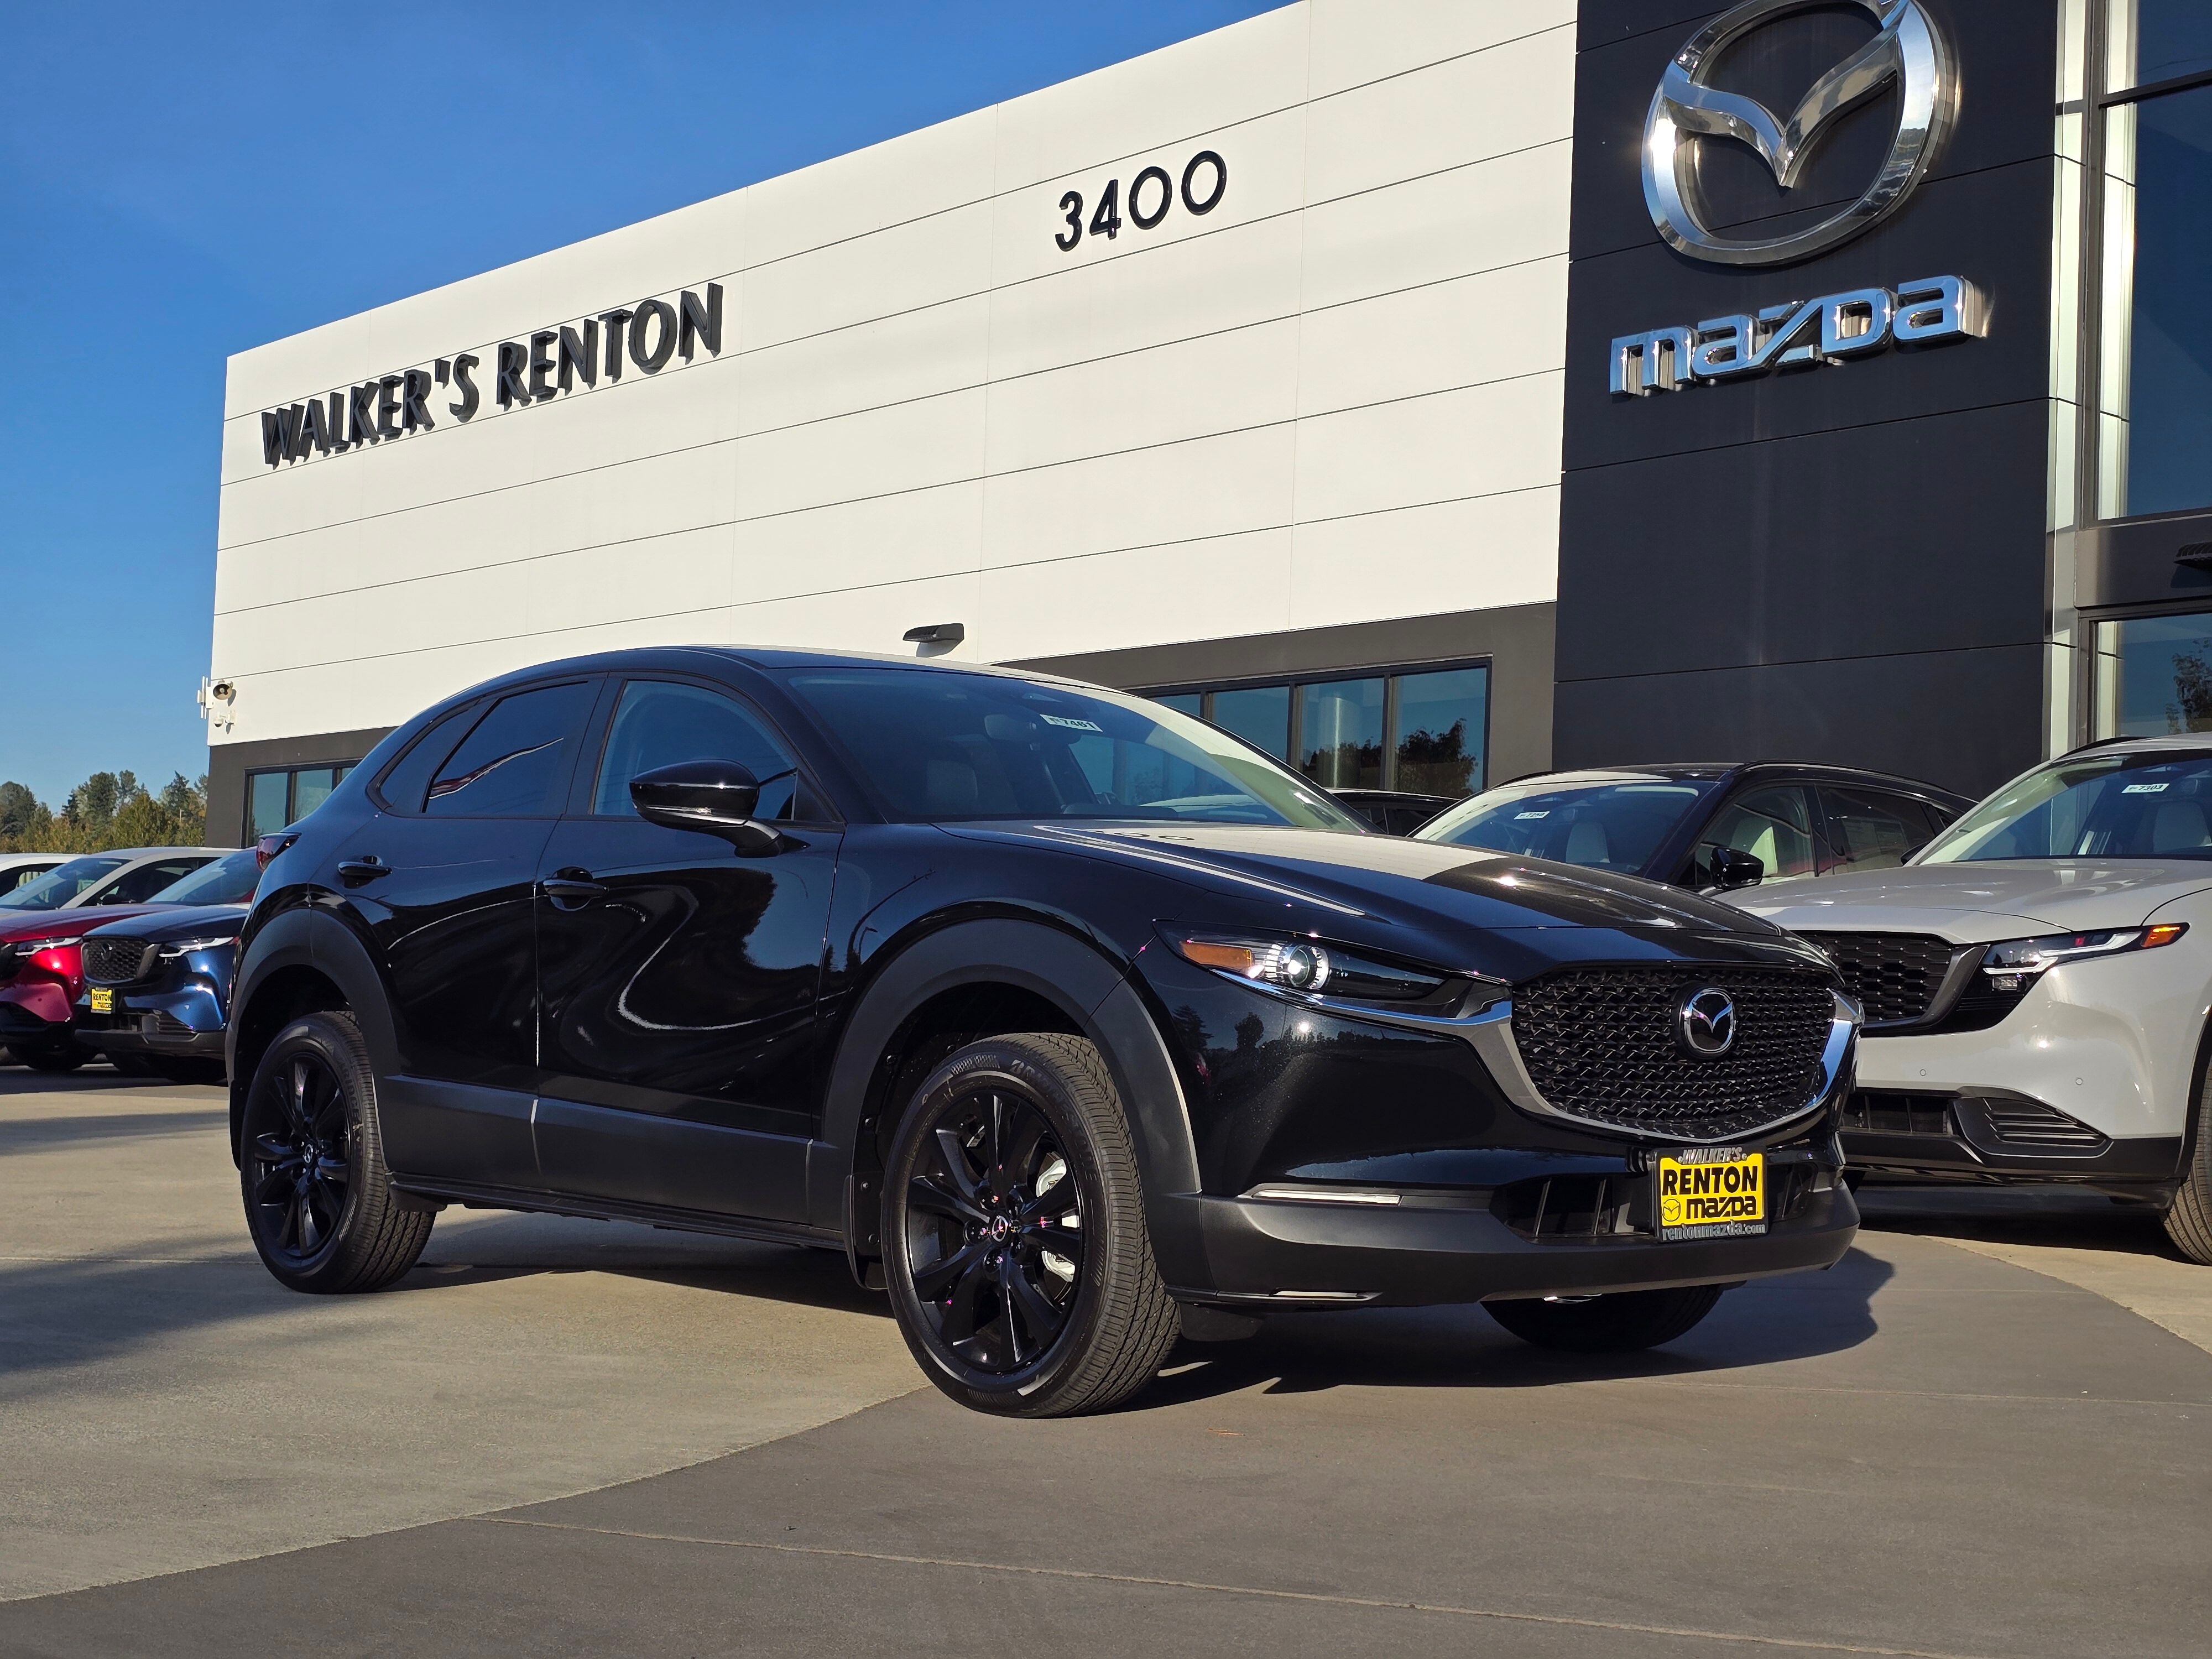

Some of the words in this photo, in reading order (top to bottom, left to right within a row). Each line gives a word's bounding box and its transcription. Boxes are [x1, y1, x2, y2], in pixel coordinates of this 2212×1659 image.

[1055, 150, 1227, 252] 3400
[1609, 275, 1986, 395] mazda
[262, 354, 479, 469] WALKER'S
[497, 283, 723, 411] RENTON
[1682, 1147, 1743, 1165] WALKER'S
[1662, 1165, 1758, 1196] RENTON
[1686, 1196, 1757, 1219] mazda
[1662, 1220, 1766, 1241] rentonmazda.com
